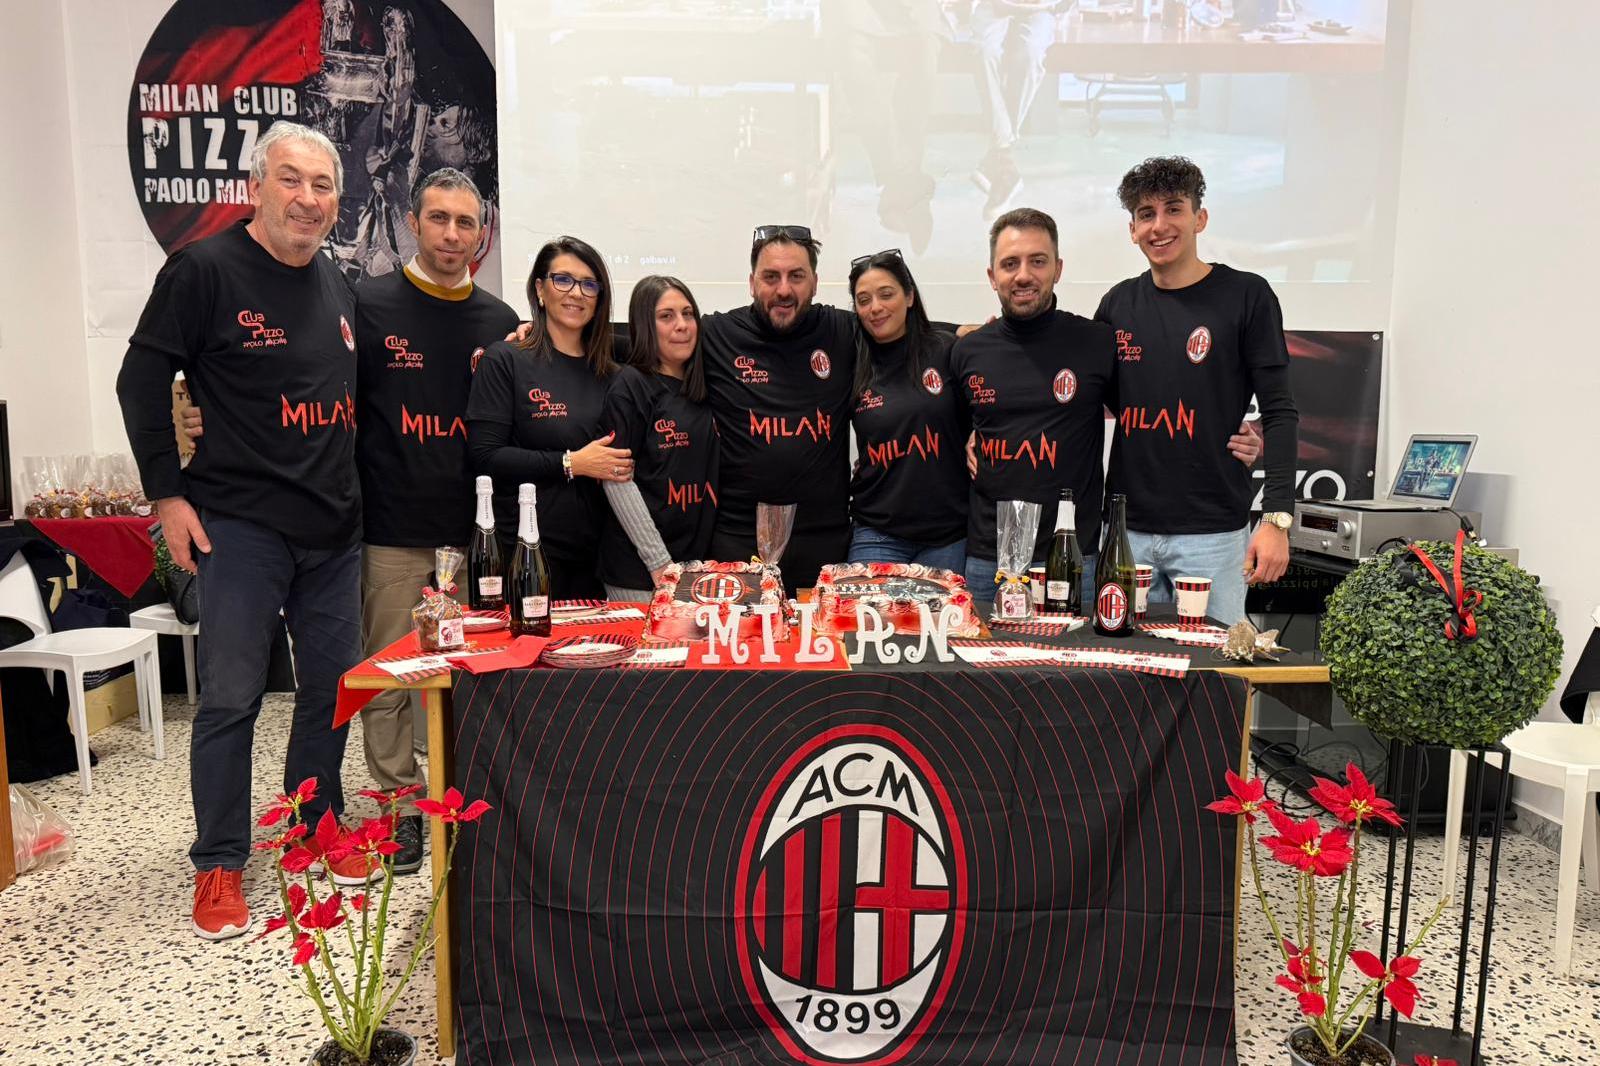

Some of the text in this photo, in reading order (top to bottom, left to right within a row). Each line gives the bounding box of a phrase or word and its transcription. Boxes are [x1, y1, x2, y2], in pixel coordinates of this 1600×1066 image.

[139, 83, 298, 116] MILAN CLUB
[142, 116, 260, 171] PIZZ
[144, 177, 252, 205] PAOLO MA
[252, 324, 285, 339] PIZZO
[395, 348, 424, 361] PIZZO
[281, 394, 356, 436] MILAN
[401, 403, 468, 444] MILA
[749, 408, 831, 445] MILAN
[1120, 398, 1195, 440] MILAN
[867, 424, 939, 471] MILAN
[979, 431, 1057, 470] MILAN
[667, 478, 718, 512] MILA
[696, 603, 963, 664] MILAN
[787, 753, 919, 824] ACM
[795, 995, 900, 1034] 1899
